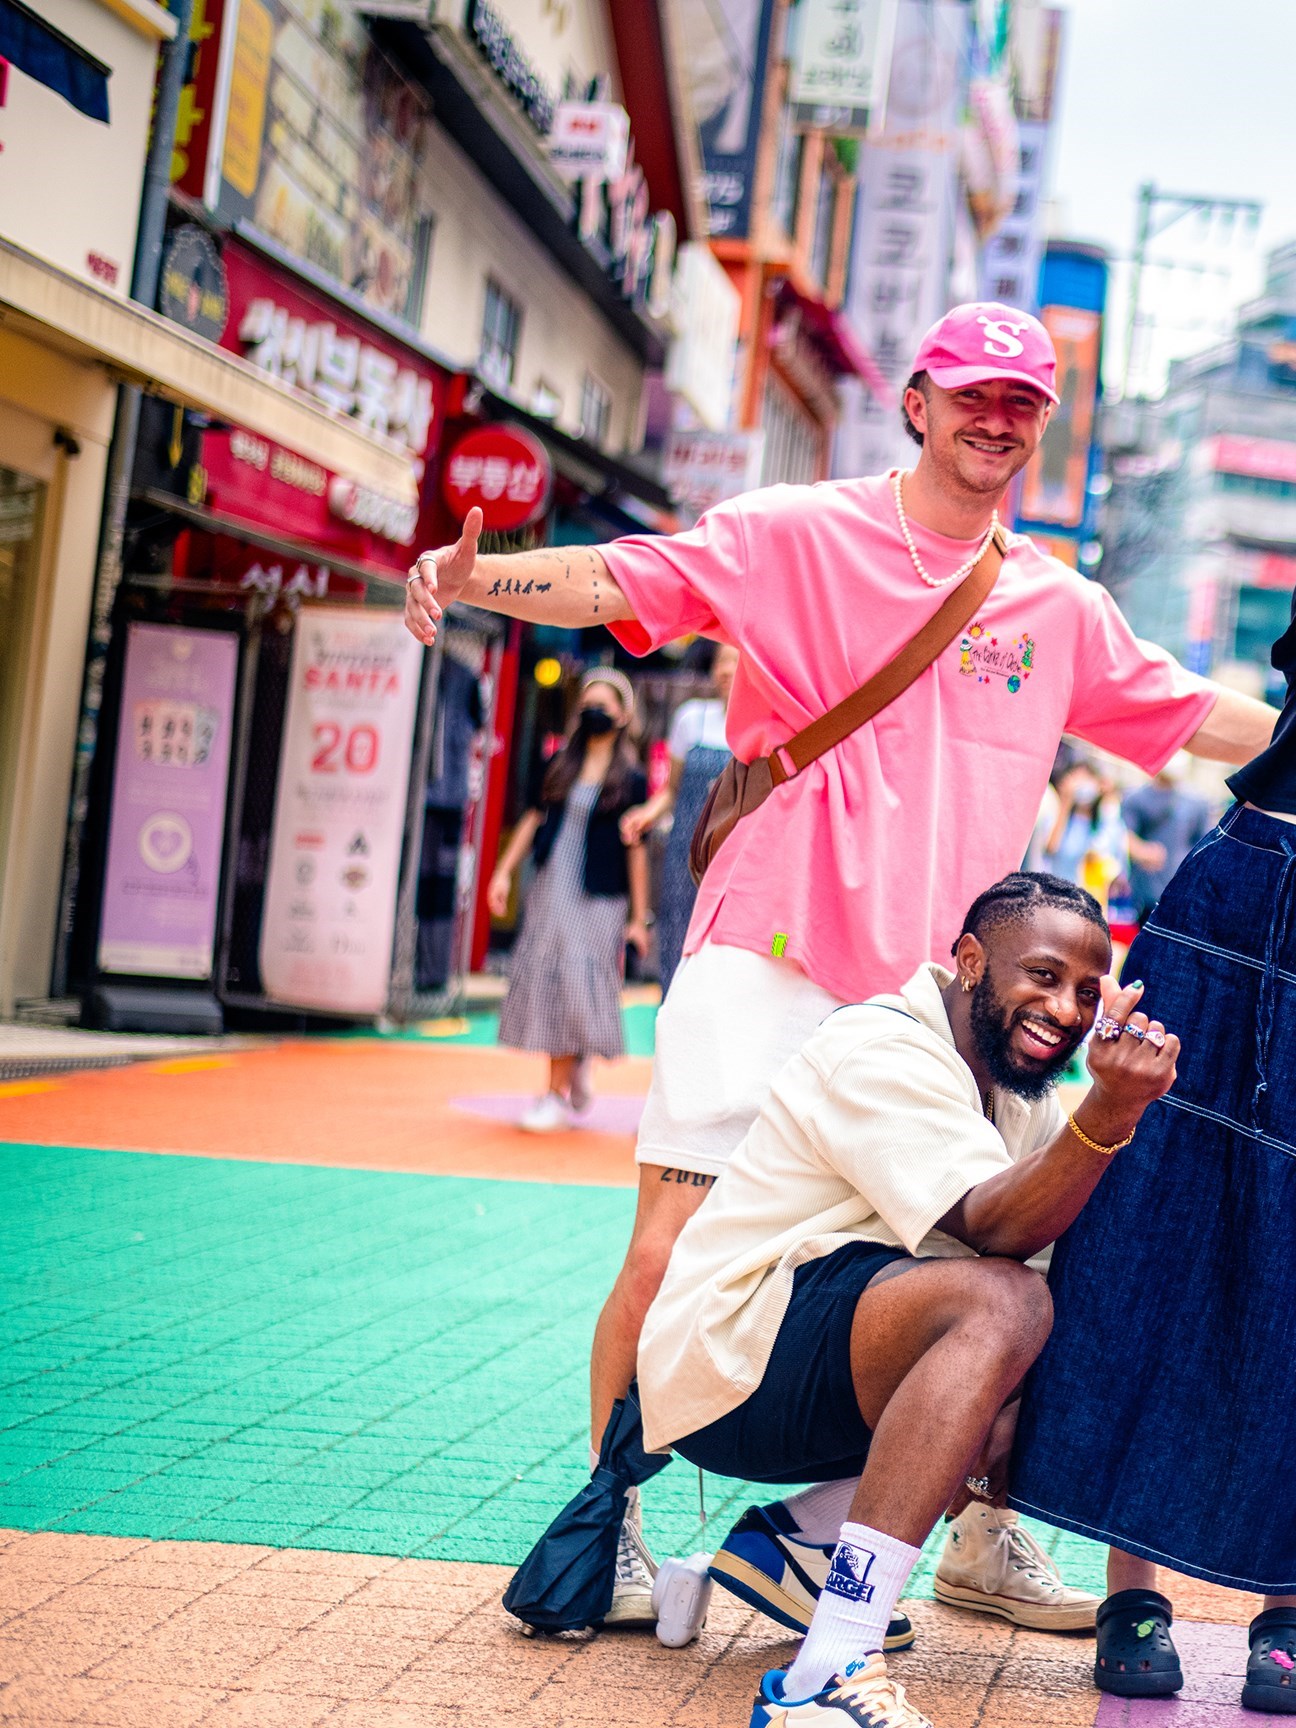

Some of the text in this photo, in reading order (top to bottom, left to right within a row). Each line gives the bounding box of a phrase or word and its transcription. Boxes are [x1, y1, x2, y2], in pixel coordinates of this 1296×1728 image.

[978, 316, 1029, 358] S
[448, 455, 540, 503] 부동산
[304, 668, 399, 694] SANTA
[312, 721, 380, 774] 20
